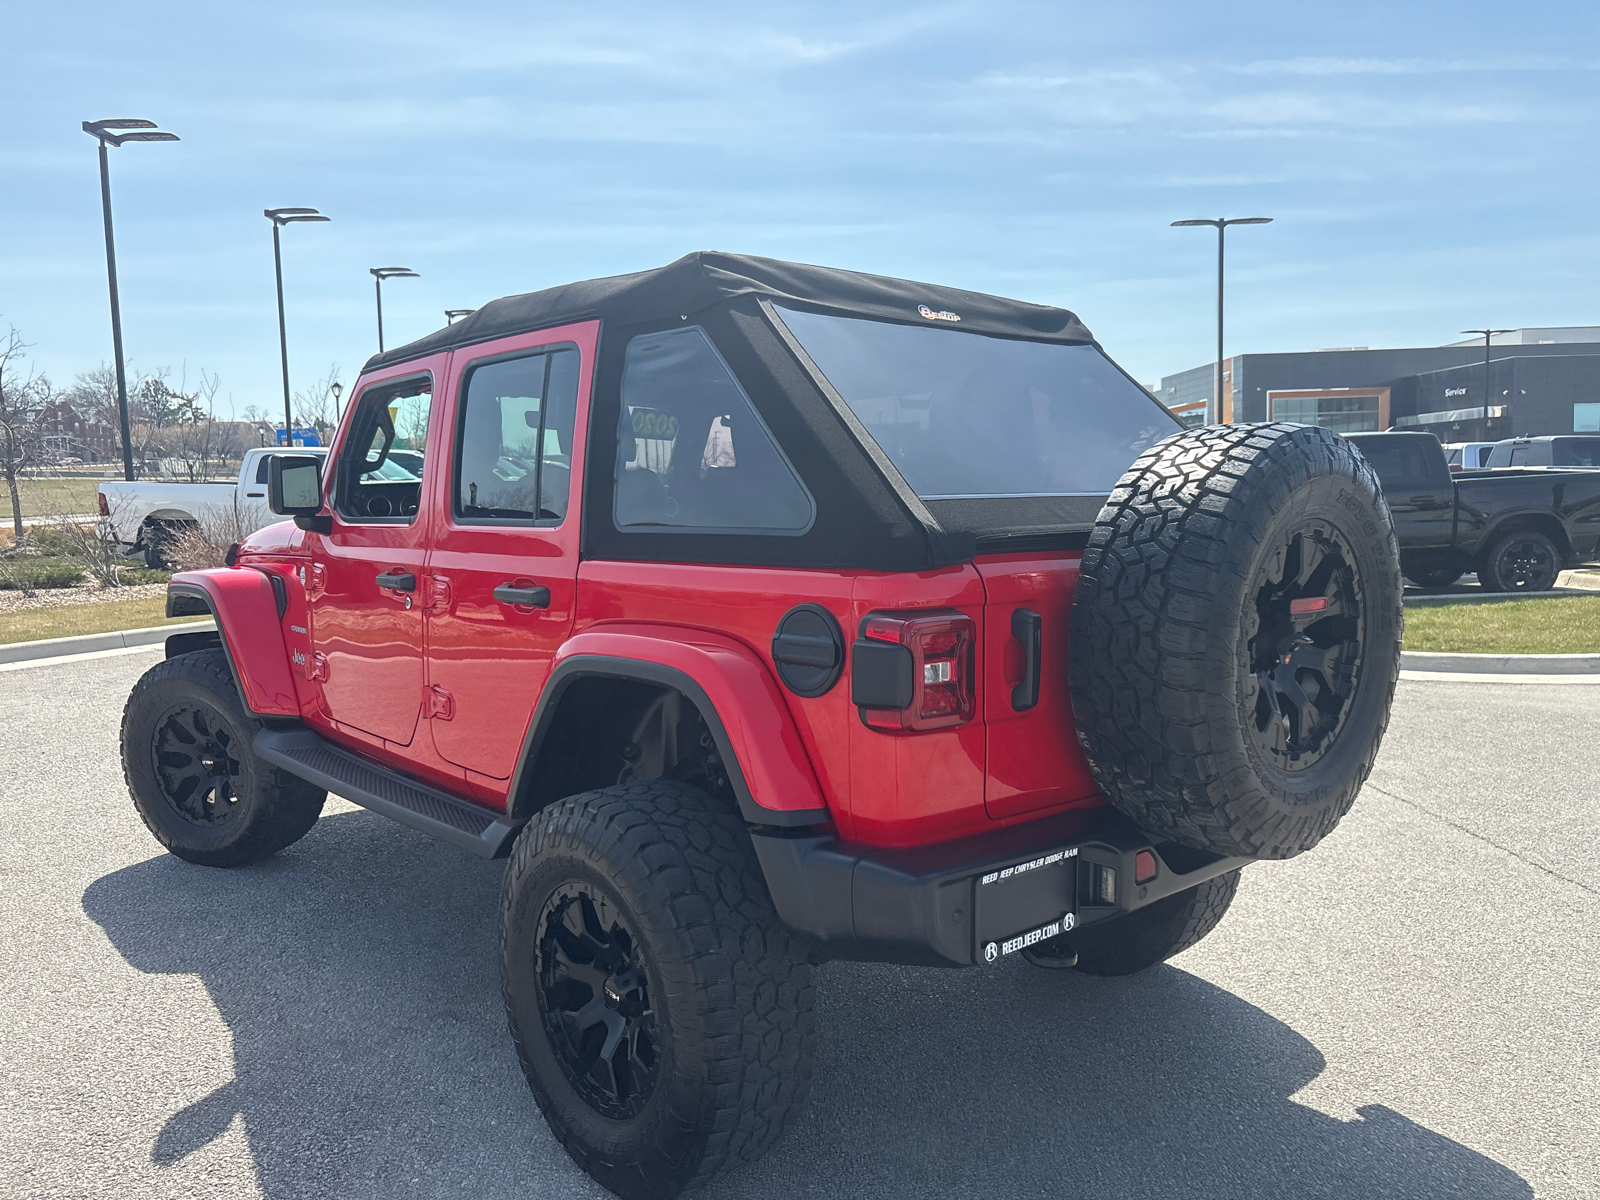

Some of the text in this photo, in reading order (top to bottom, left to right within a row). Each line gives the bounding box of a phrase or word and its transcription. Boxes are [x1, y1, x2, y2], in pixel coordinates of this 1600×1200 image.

[1444, 387, 1468, 398] Service
[1336, 488, 1379, 538] TOYO
[292, 647, 306, 666] Jee
[982, 847, 1078, 885] REED JEEP CHRYSLER DODGE RAM
[1002, 922, 1059, 956] REEDJEEP.COM
